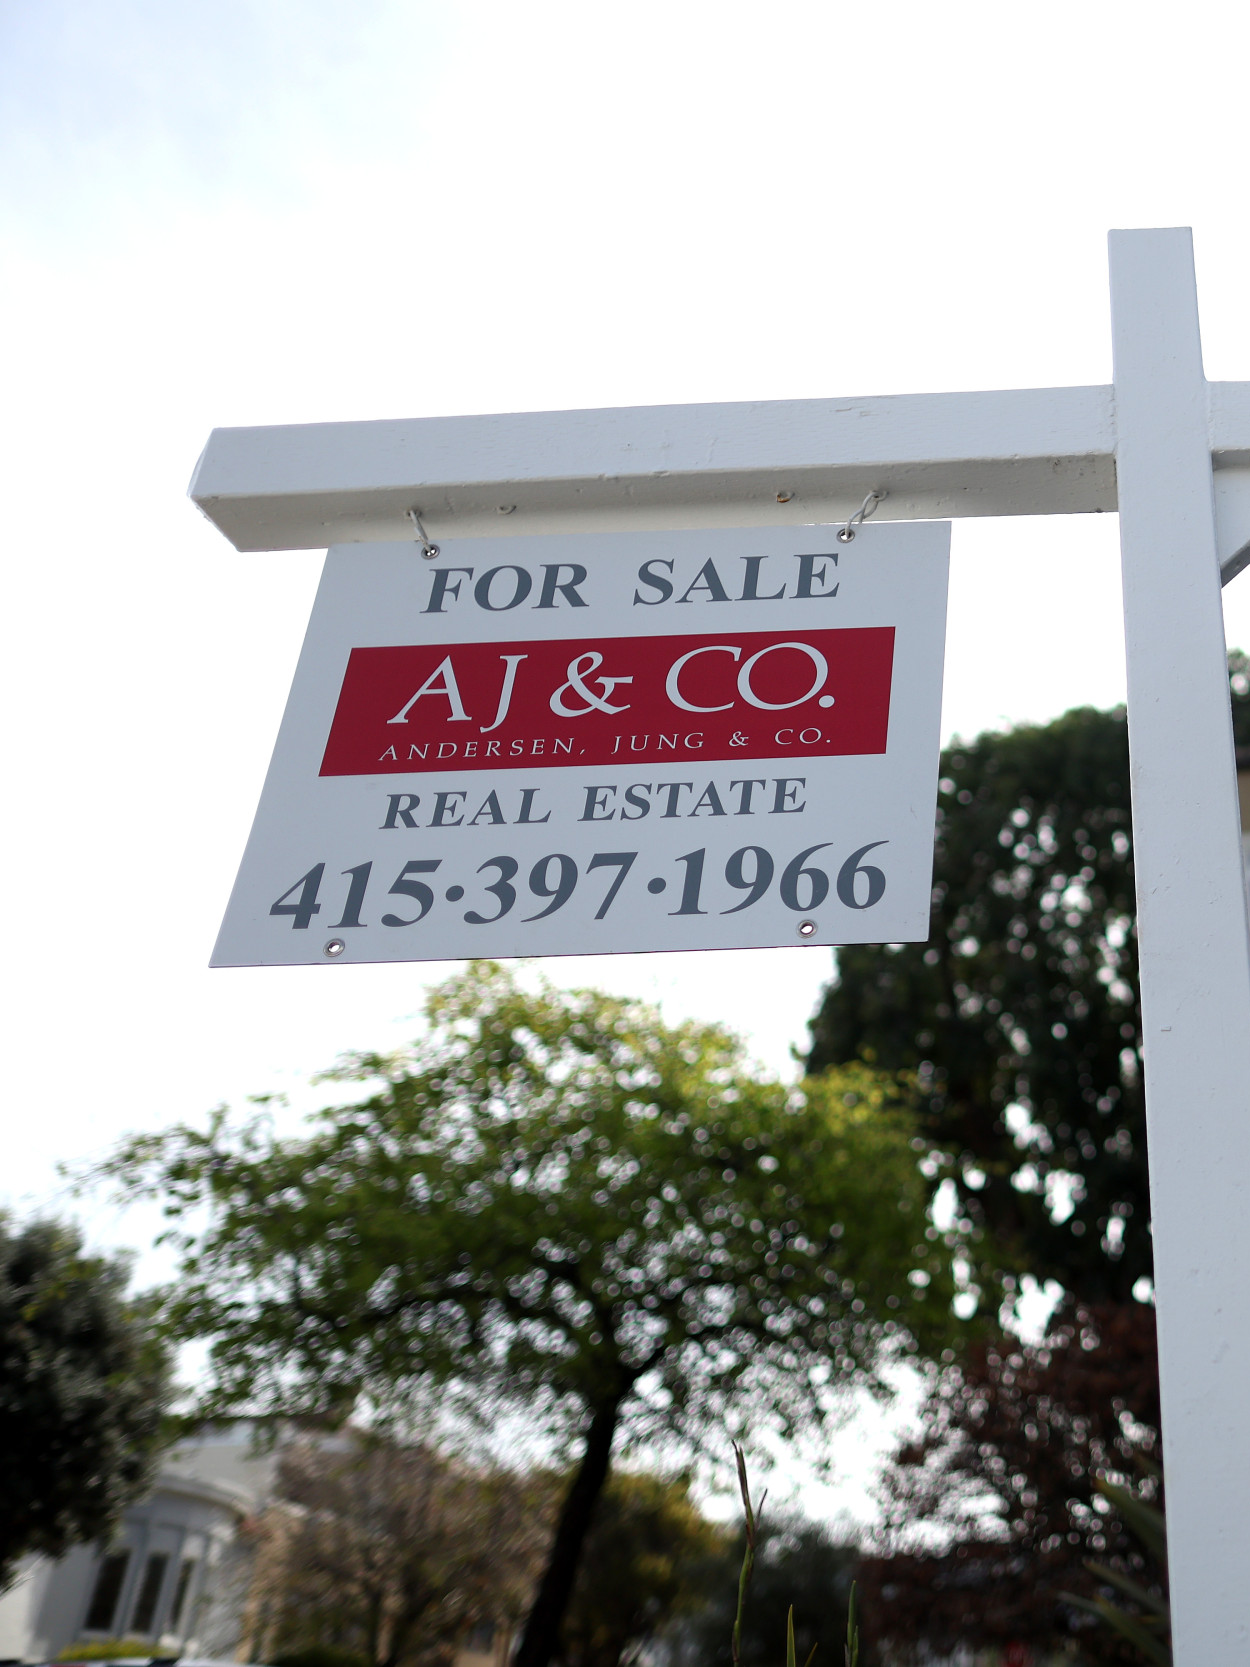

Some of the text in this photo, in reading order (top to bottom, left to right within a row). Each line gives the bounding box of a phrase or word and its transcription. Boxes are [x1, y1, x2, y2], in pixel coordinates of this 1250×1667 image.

[418, 552, 840, 614] FOR SALE
[386, 641, 835, 734] AJ & CO.
[378, 727, 832, 761] ANDERSEN, JUNG & CO.
[378, 777, 807, 830] REAL ESTATE
